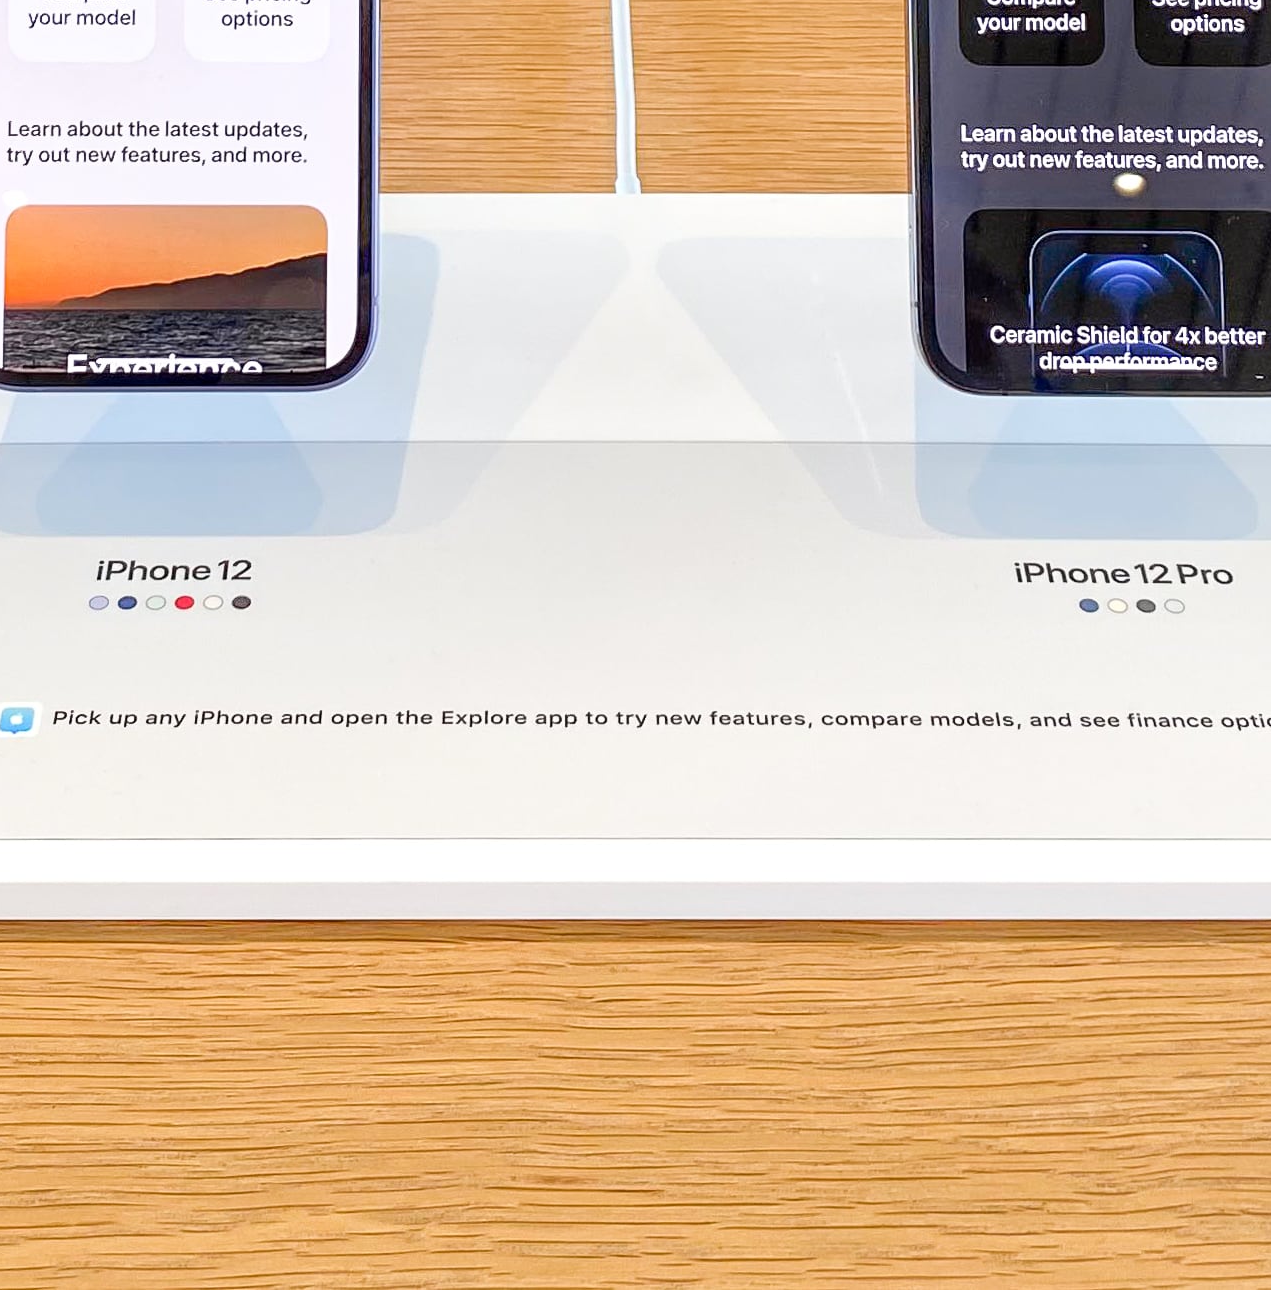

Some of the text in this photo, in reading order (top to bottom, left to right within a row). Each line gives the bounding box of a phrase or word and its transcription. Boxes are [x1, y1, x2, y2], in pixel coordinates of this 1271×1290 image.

[29, 10, 135, 28] your model
[222, 12, 293, 30] options
[977, 13, 1085, 34] your model
[1171, 14, 1245, 35] options
[8, 121, 307, 140] Learn about the latest updates,
[961, 125, 1263, 147] Learn about the latest updates,
[7, 146, 306, 166] try out new features, and more.
[961, 150, 1264, 172] try out new features, and more.
[990, 325, 1266, 345] Ceramic Shield for 4x better
[1039, 351, 1086, 374] drop
[96, 560, 252, 581] iPhone 12
[1014, 562, 1233, 584] iPhone 12 Pro
[53, 710, 101, 724] Pick
[110, 714, 137, 727] up
[146, 714, 186, 727] any
[195, 710, 272, 724] iPhone
[281, 710, 322, 724] and
[332, 714, 387, 727] open
[396, 710, 432, 724] the
[442, 711, 526, 727] Explore
[535, 714, 577, 727] app
[586, 712, 607, 724] to
[616, 712, 647, 728] try
[656, 714, 701, 725] new
[710, 711, 812, 728] features,
[822, 715, 921, 729] compare
[931, 712, 1021, 729] models,
[1031, 713, 1071, 727] and
[1079, 716, 1120, 728] see
[1127, 713, 1212, 727] finance
